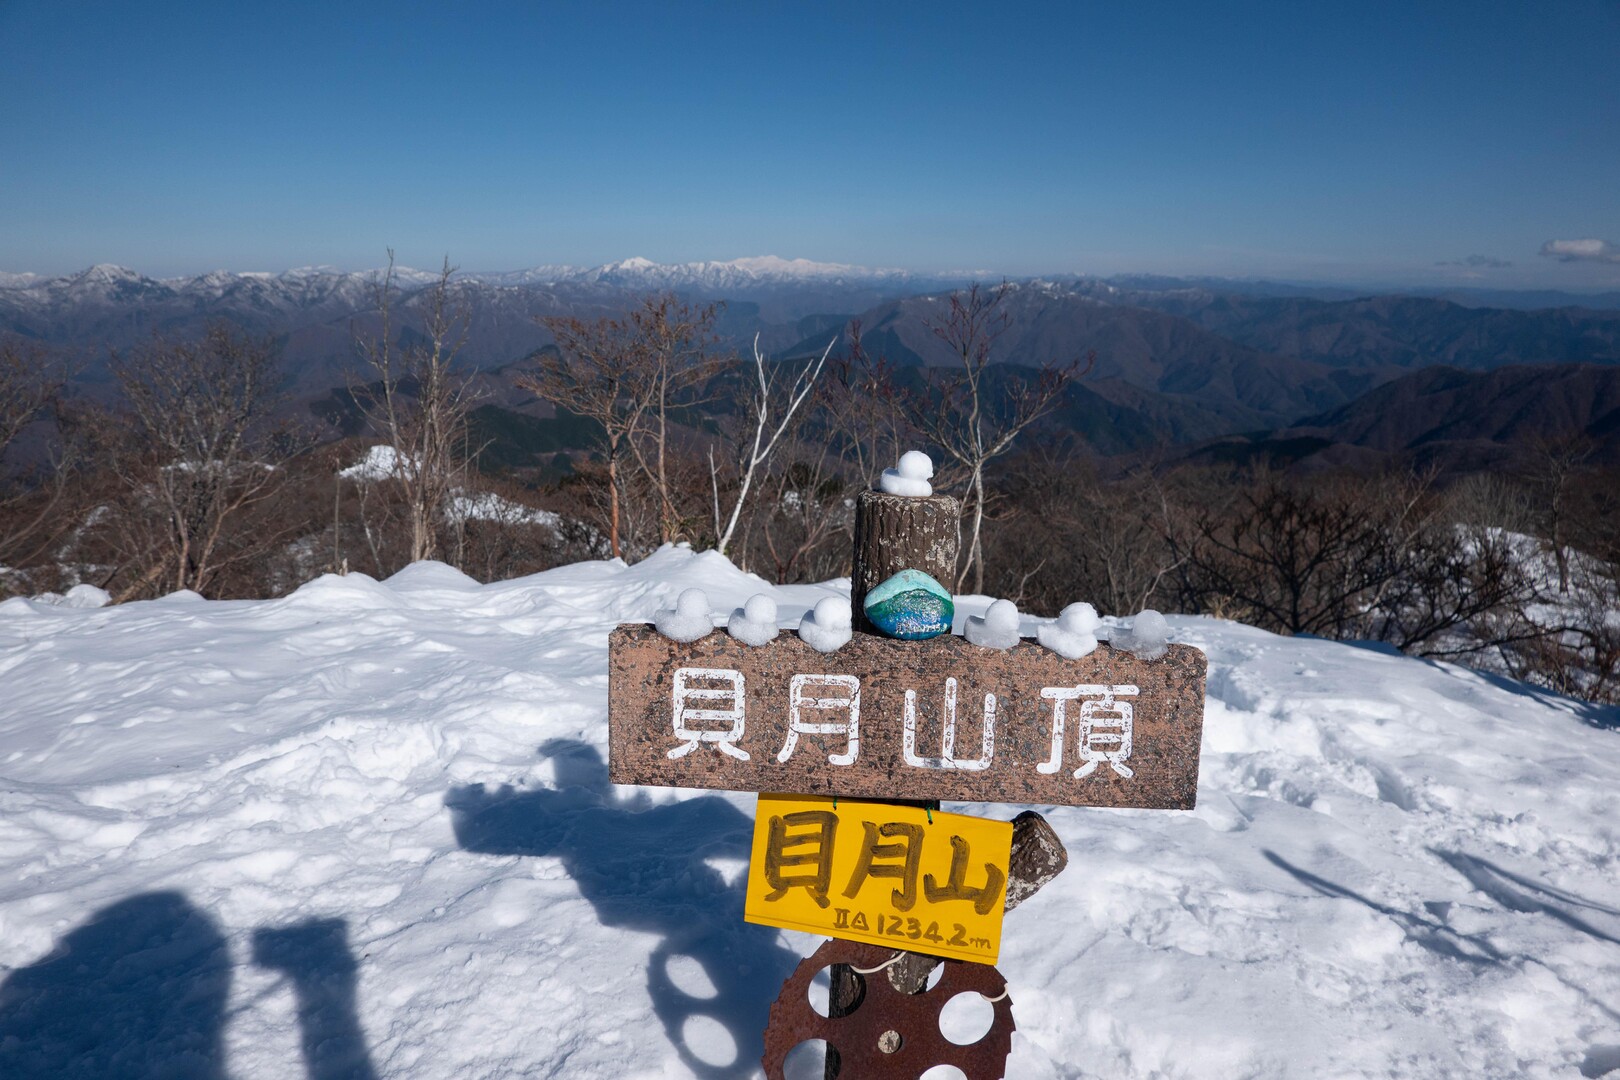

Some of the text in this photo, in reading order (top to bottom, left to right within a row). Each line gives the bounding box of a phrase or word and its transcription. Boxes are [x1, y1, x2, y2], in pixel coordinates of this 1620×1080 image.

[667, 667, 1140, 779] 貝月山頂
[764, 810, 1005, 915] 貝月山
[877, 913, 992, 949] 1234.2m
